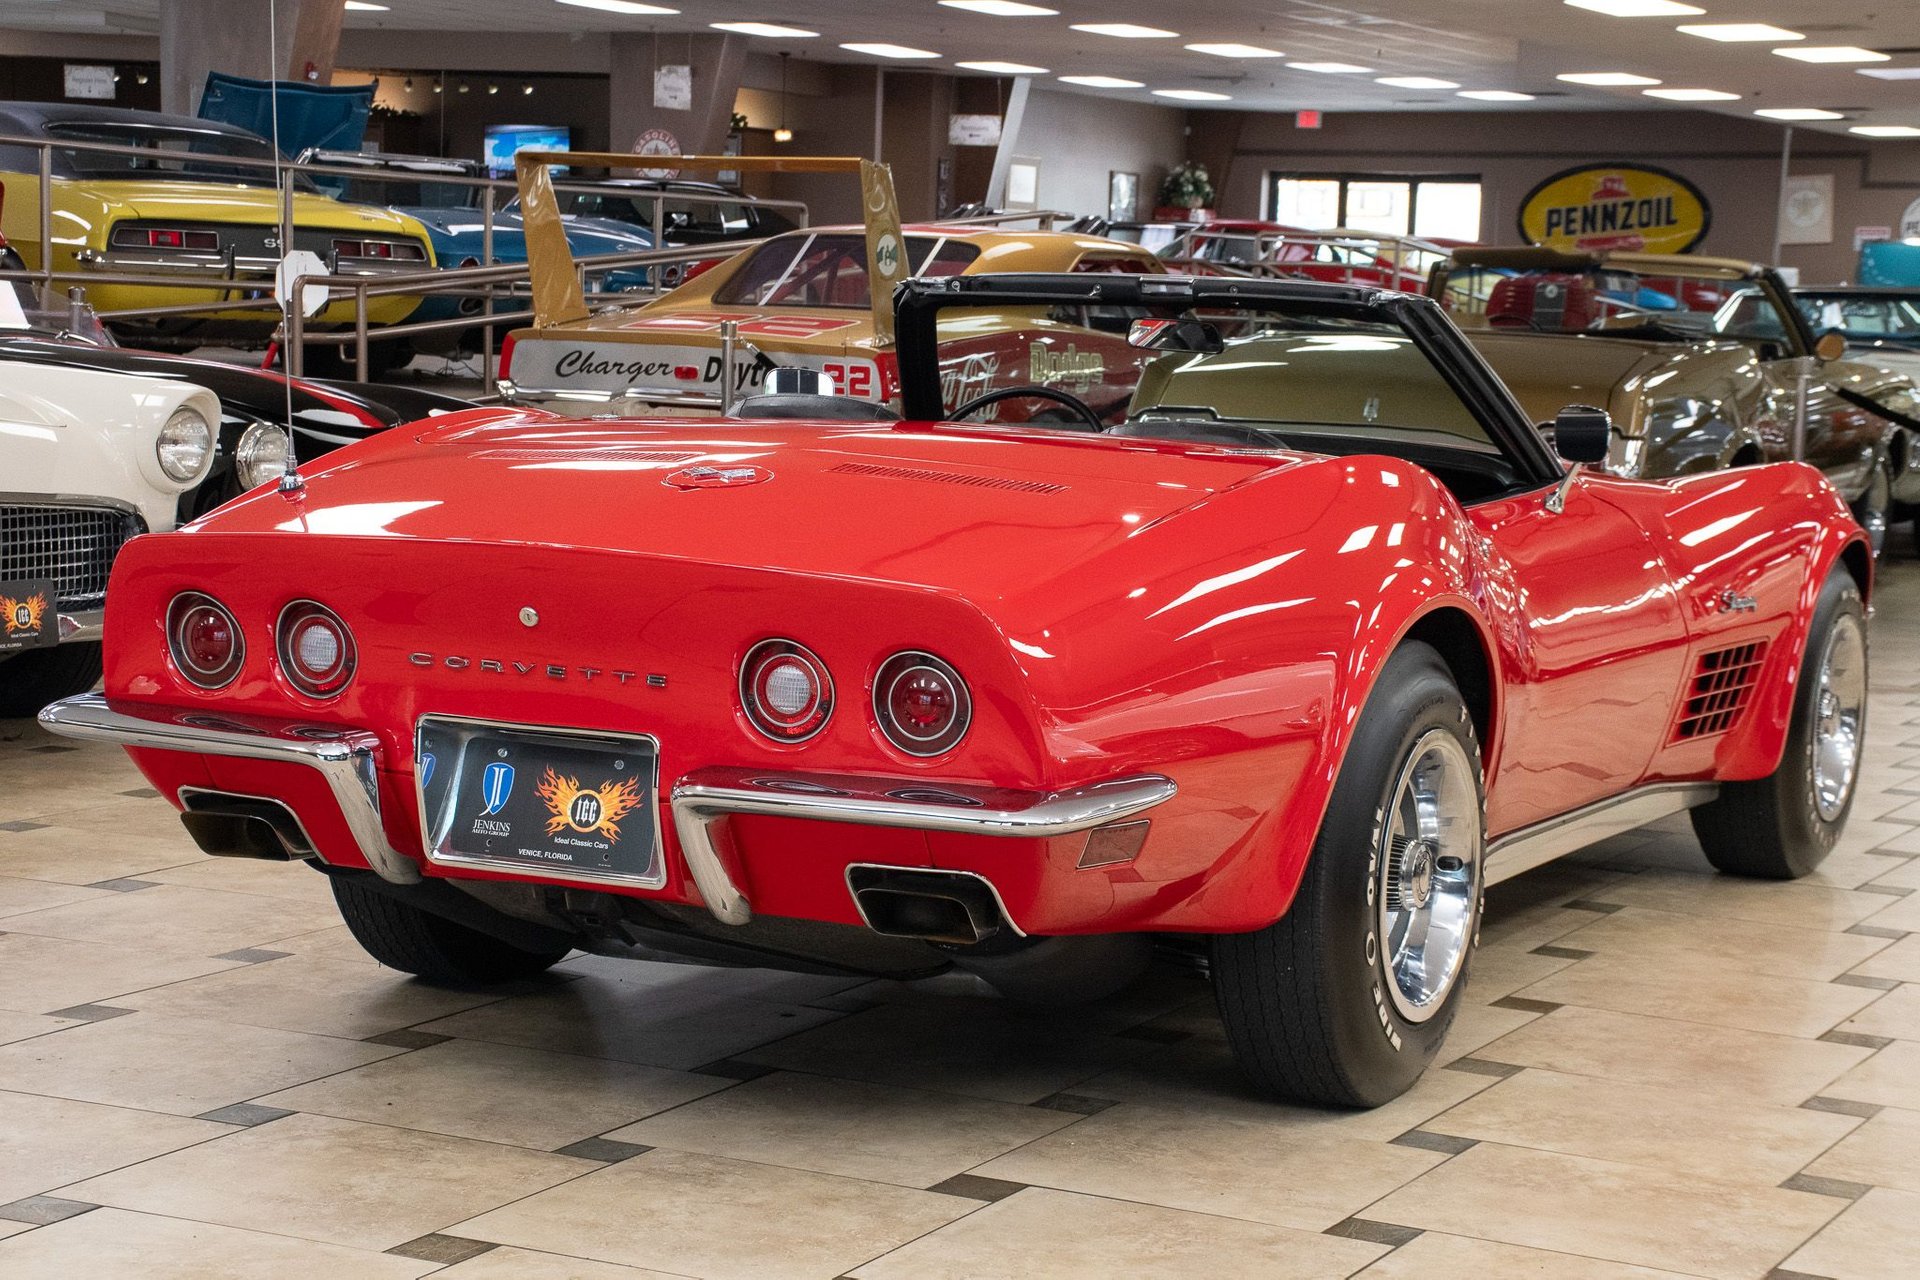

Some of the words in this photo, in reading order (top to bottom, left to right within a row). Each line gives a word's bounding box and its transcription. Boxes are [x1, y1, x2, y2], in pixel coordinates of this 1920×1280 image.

[1546, 197, 1677, 237] PENNZOIL
[555, 350, 673, 384] Charger
[1030, 342, 1104, 394] Dodge
[409, 652, 667, 687] CORVETTE
[473, 819, 511, 833] JENKINS
[575, 797, 598, 824] ICC
[518, 848, 543, 858] VENICE,
[544, 851, 573, 861] FLORIDA
[554, 836, 570, 845] Ideal
[570, 838, 593, 848] Classic
[593, 841, 609, 850] Cars
[1366, 806, 1385, 906] OVAL
[1373, 980, 1402, 1053] WIDE
